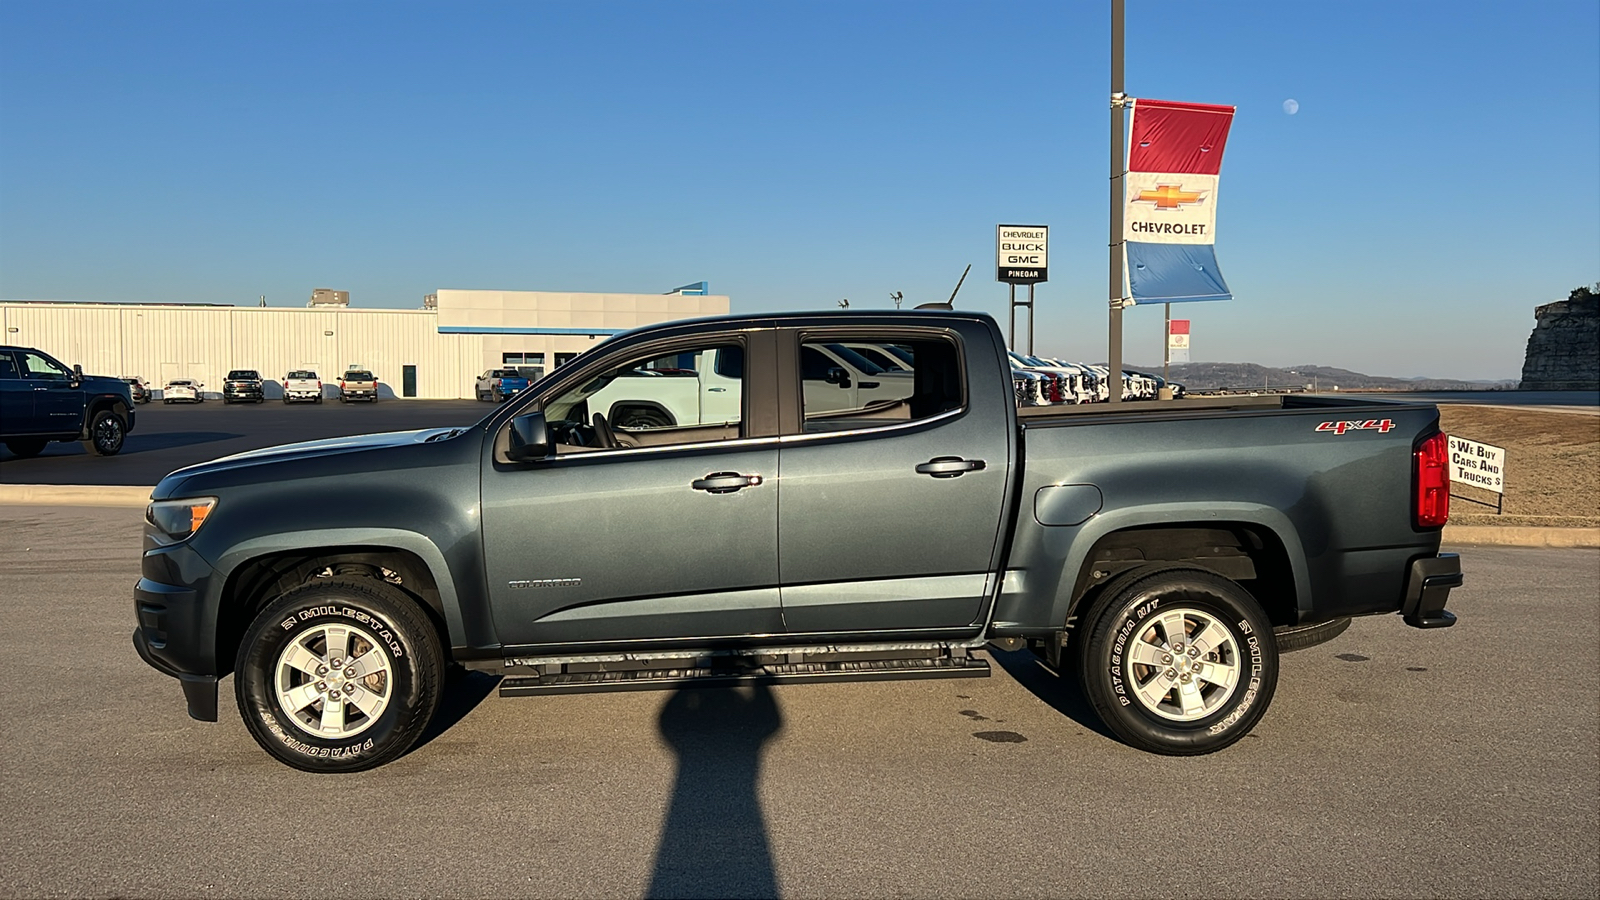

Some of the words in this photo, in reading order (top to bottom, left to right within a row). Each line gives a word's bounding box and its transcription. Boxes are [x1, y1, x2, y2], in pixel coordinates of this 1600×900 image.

[1002, 231, 1044, 239] CHEVROLET
[1131, 221, 1206, 235] CHEVROLET
[1002, 243, 1044, 251] BUICK
[1008, 255, 1039, 264] GMC
[1452, 453, 1477, 469] CARS
[1480, 460, 1499, 474] AND
[1458, 467, 1492, 485] TRUCKS
[508, 578, 581, 588] COLORADO
[298, 605, 403, 658] MILESTAR
[1111, 619, 1136, 707] PATAGONIA
[1209, 636, 1262, 735] MILESTAR
[282, 735, 374, 758] PATAGONIA
